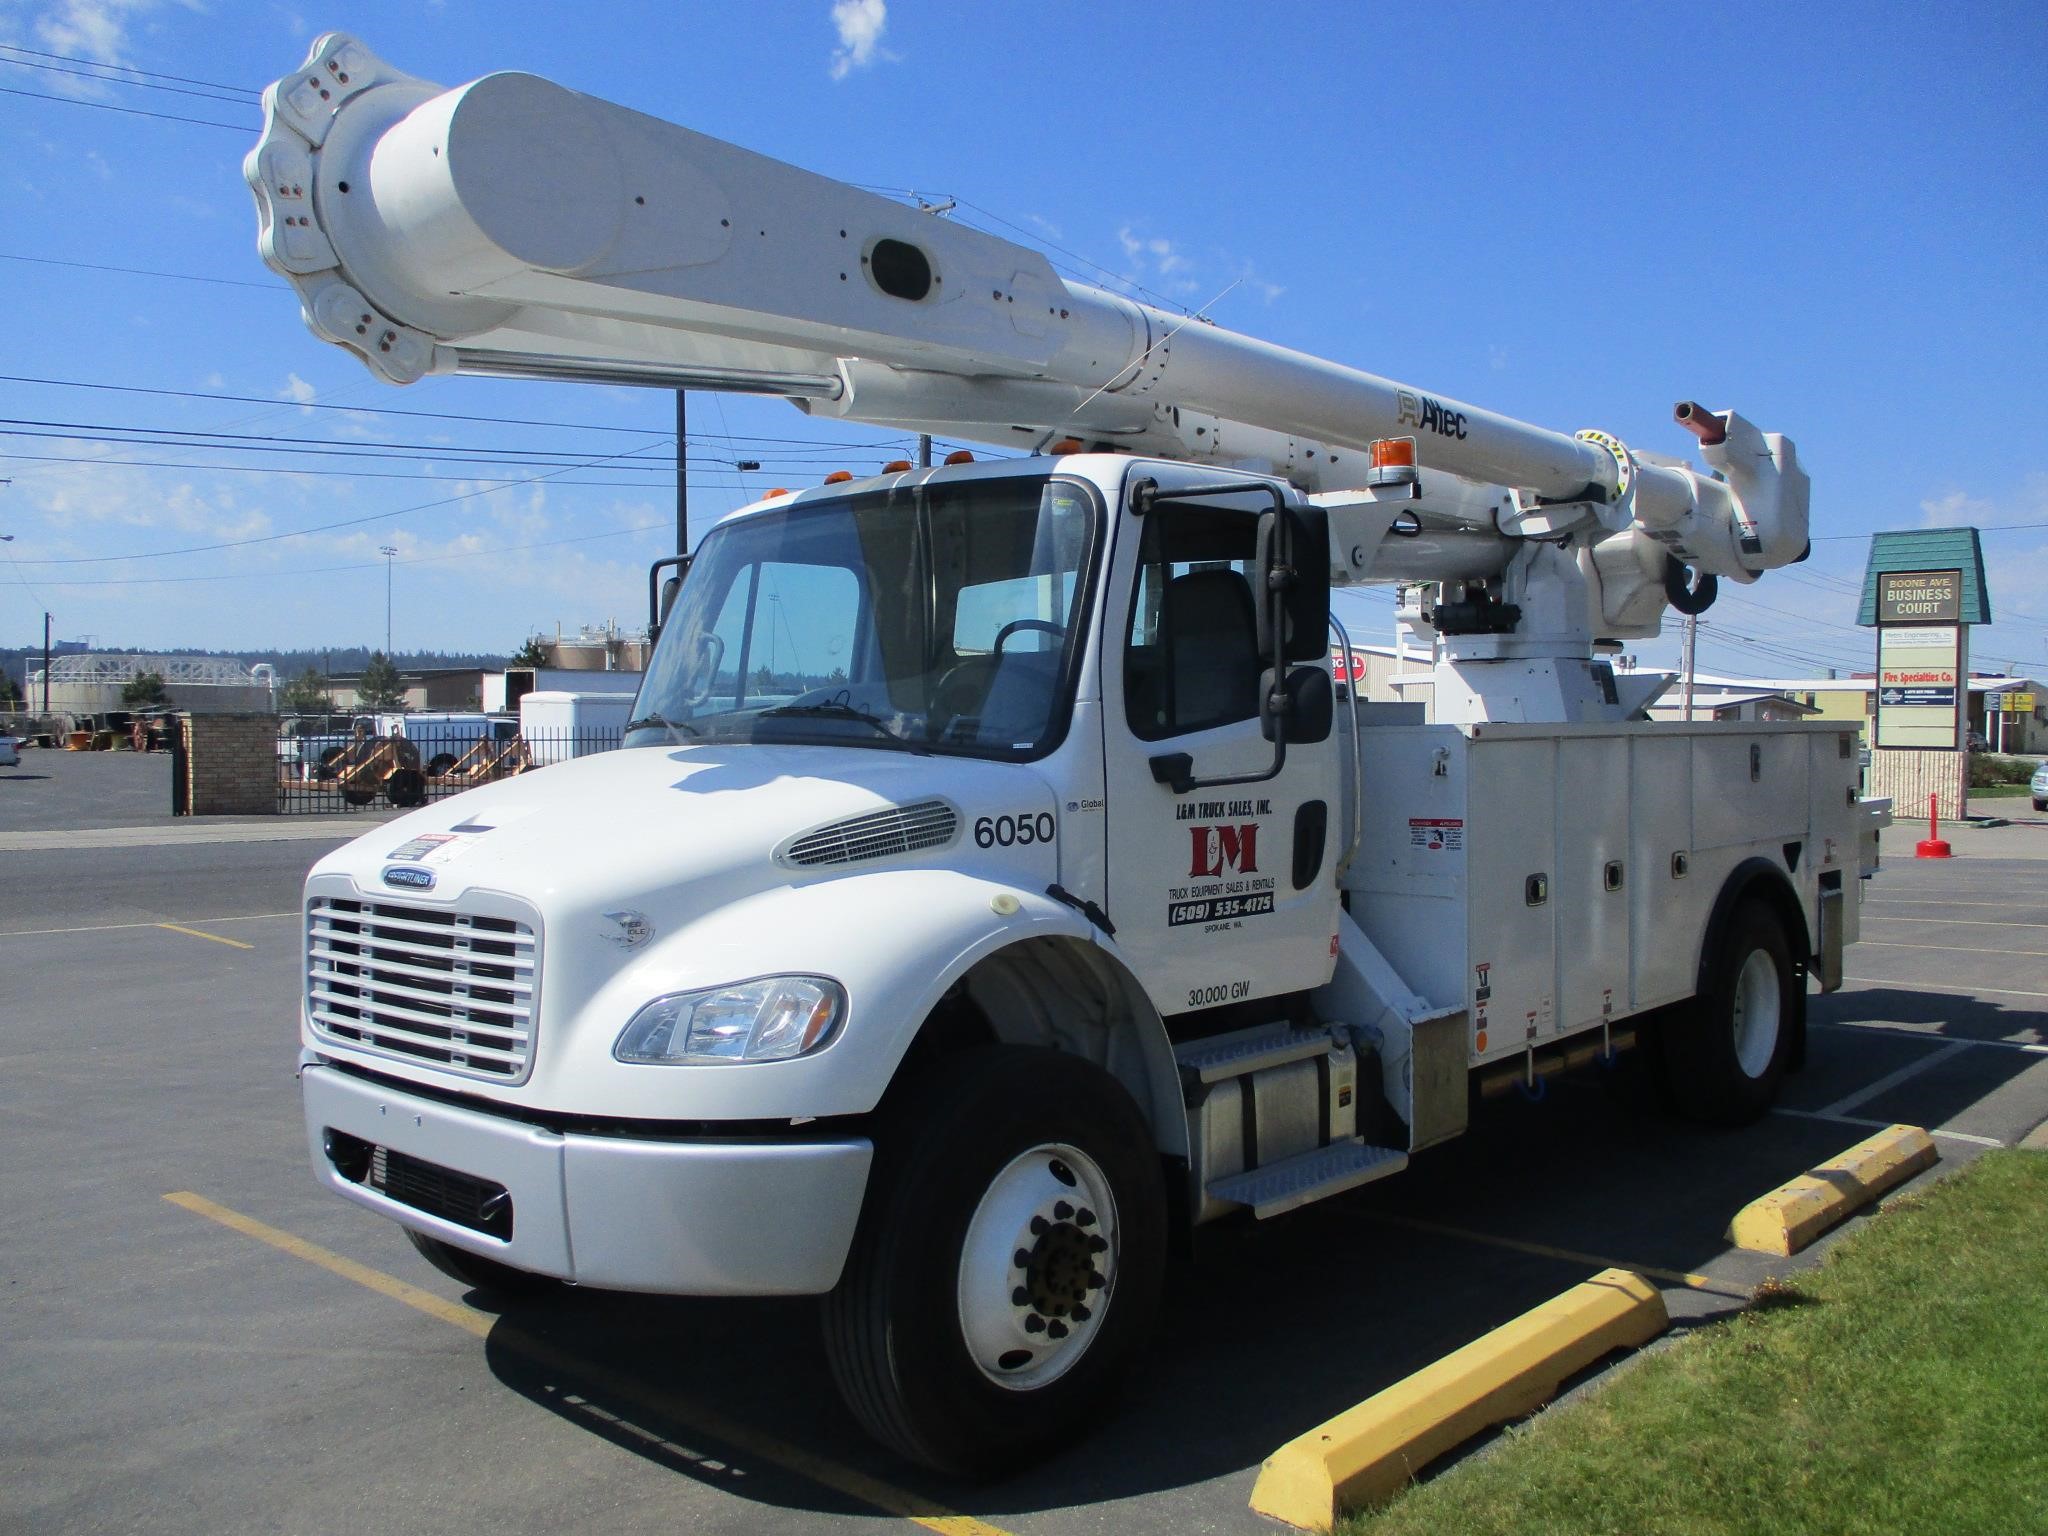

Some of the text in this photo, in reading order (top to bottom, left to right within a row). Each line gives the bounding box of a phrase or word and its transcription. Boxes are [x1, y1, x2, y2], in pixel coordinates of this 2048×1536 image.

[1889, 580, 1926, 588] BOONE
[1887, 588, 1952, 601] BUSINESS
[1897, 602, 1940, 614] COURT
[1884, 671, 1953, 685] Fire Specialties Co.
[1081, 799, 1104, 809] Global
[1176, 799, 1273, 820] L&M TRUCK SALES, INC.
[974, 812, 1055, 849] 6050
[1169, 887, 1189, 900] TRUCK
[1191, 883, 1224, 897] EQUIPMENT
[1225, 881, 1244, 894] SALES
[1252, 877, 1276, 890] RENTALS
[1172, 896, 1272, 924] (509) 535-4175
[1188, 980, 1250, 1007] 30,000 GW
